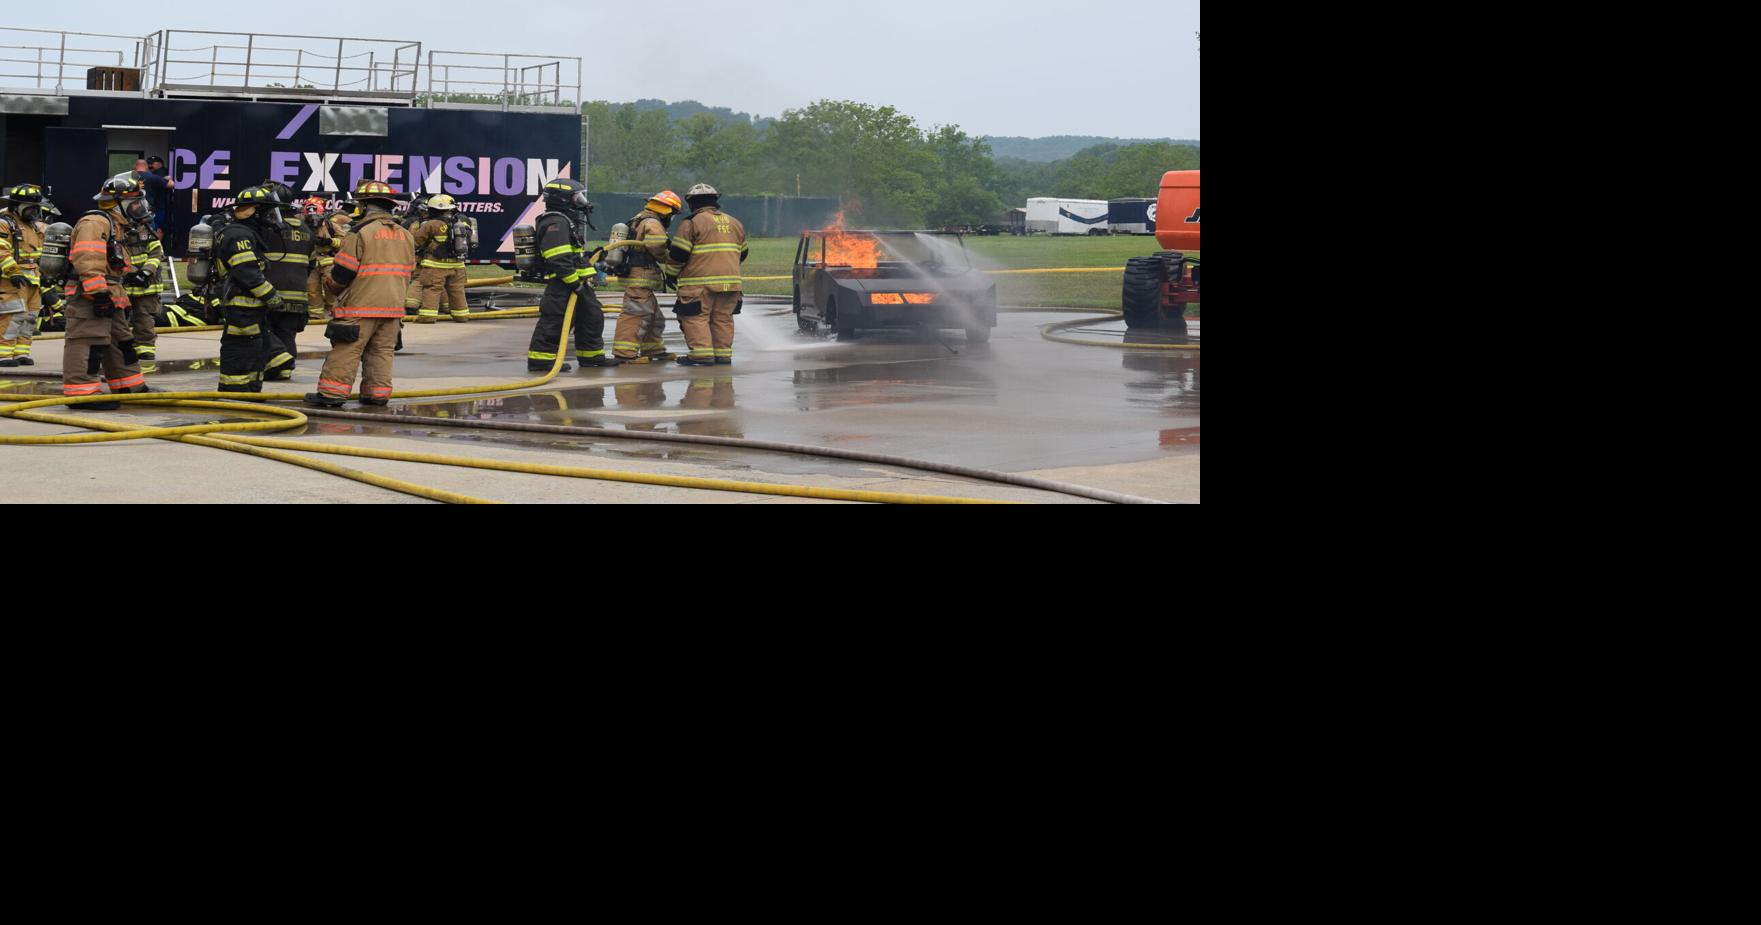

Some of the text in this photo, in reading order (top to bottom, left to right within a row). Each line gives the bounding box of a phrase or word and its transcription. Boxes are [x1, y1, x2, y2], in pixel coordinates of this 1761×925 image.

[270, 151, 559, 197] EXTENSION
[456, 201, 505, 213] ATTERS.
[236, 239, 252, 251] NC
